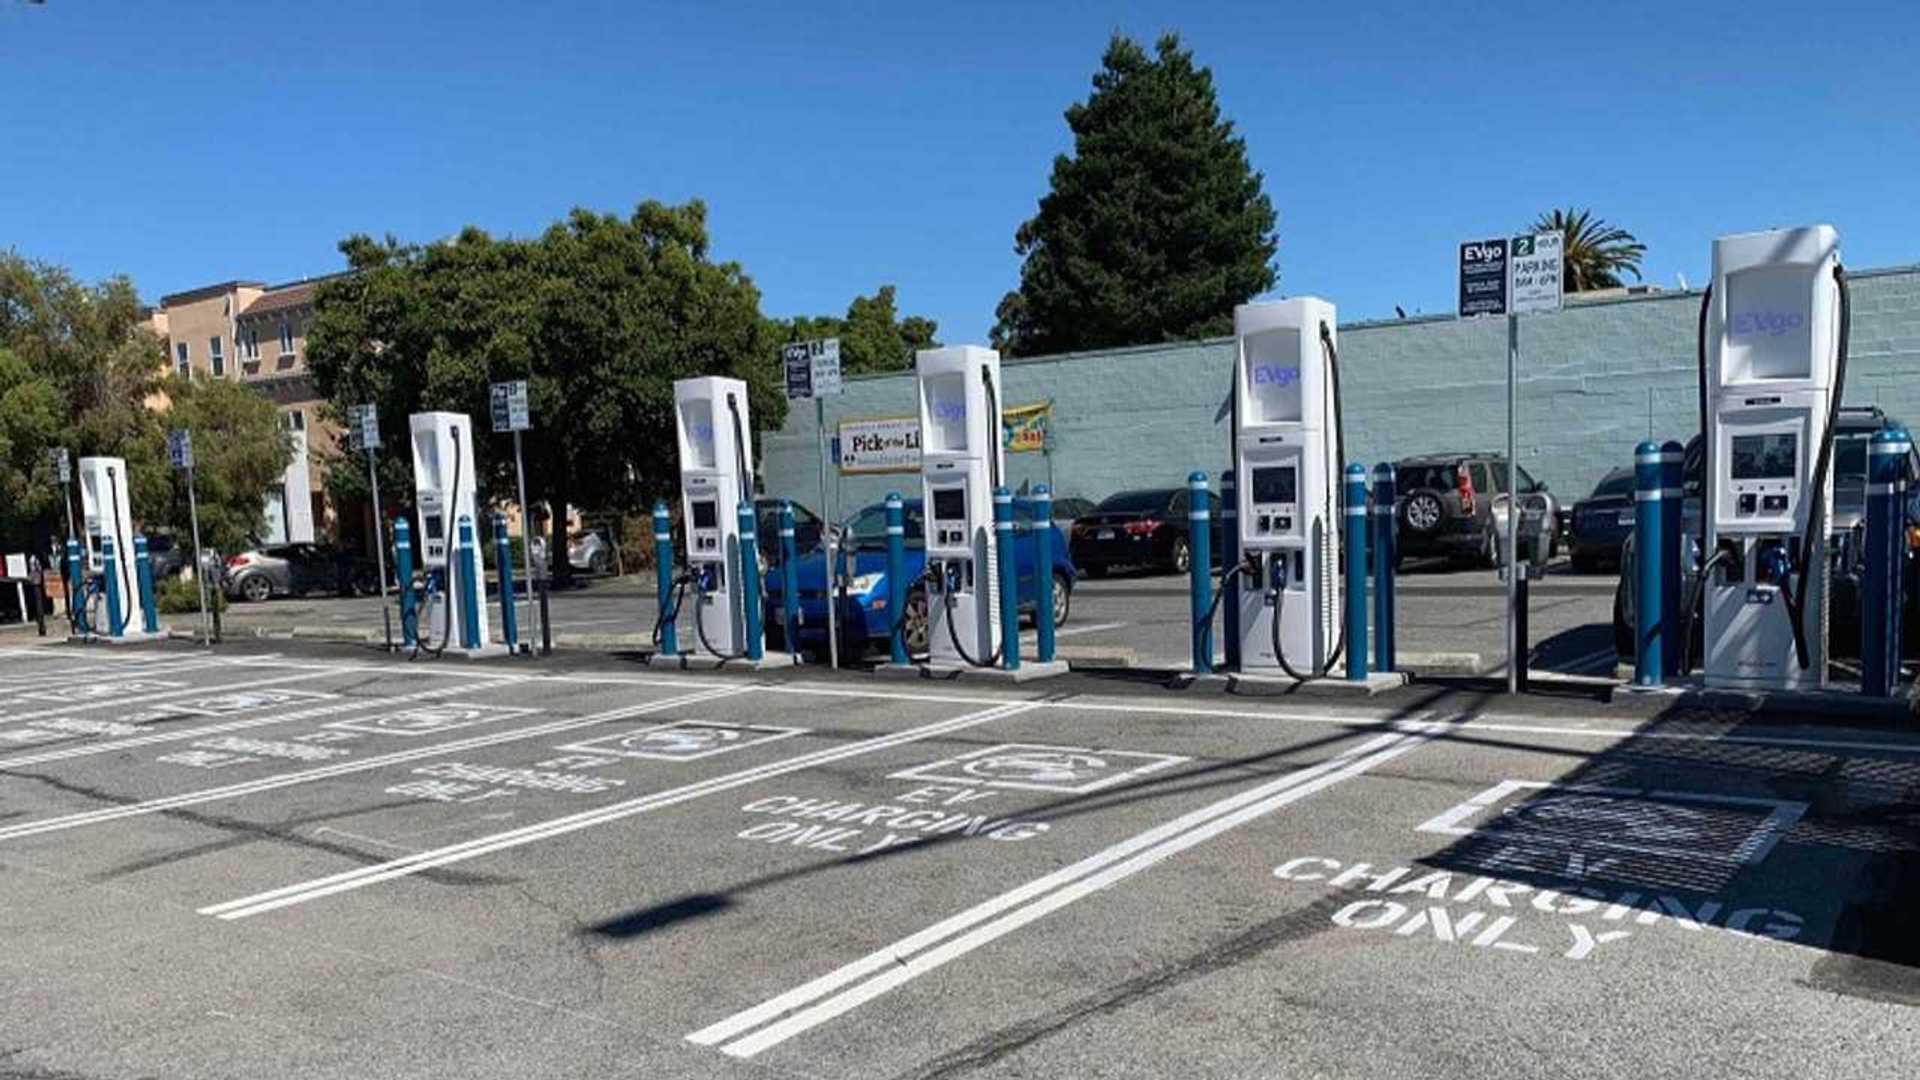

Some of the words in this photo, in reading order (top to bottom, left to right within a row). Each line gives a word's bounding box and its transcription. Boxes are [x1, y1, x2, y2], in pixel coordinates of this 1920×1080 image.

[1464, 244, 1502, 262] EVgo
[1518, 239, 1529, 255] 2
[1734, 311, 1804, 337] EVgo
[853, 433, 883, 452] Pick
[905, 430, 920, 449] Li
[895, 785, 998, 805] EV
[742, 796, 1050, 841] CHARGING
[737, 822, 922, 855] ONLY
[1272, 856, 1806, 940] CHARGING
[1330, 899, 1633, 960] ONLY
